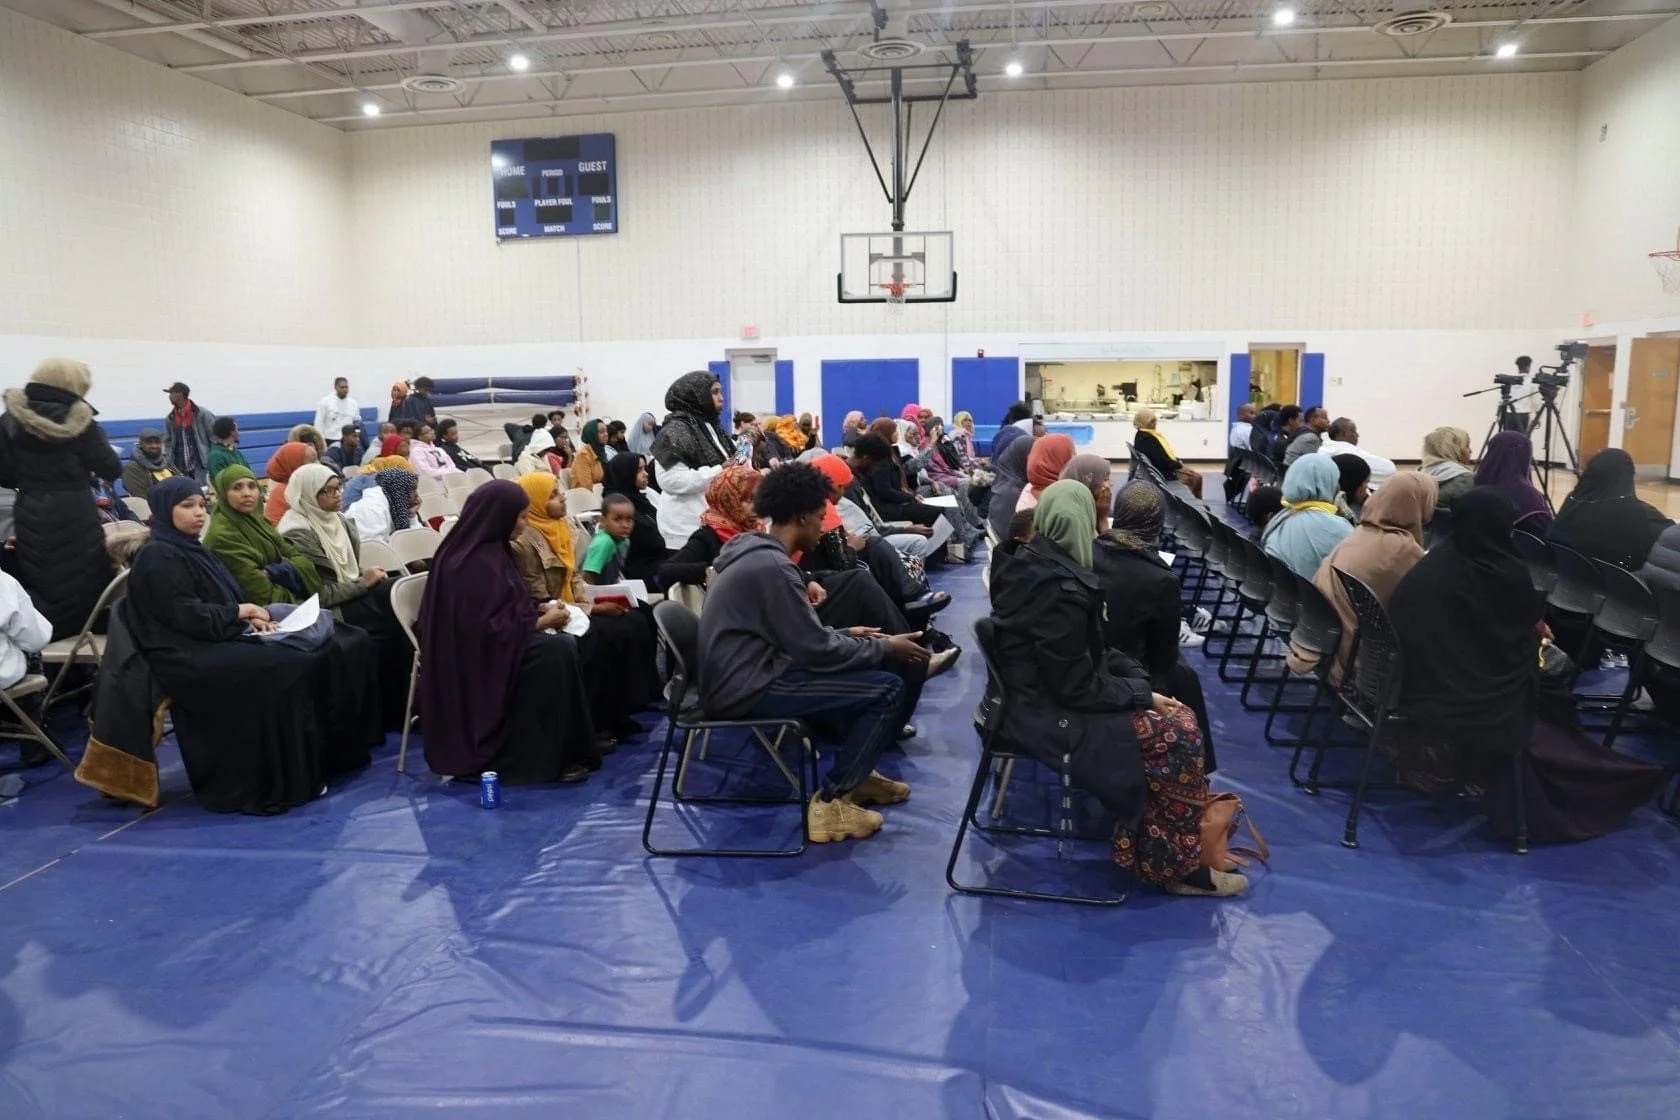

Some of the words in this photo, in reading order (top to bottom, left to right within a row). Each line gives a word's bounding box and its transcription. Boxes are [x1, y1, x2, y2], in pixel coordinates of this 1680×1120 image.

[500, 165, 526, 176] HOME
[578, 161, 607, 172] GUEST
[541, 169, 564, 177] PERIOD
[534, 199, 557, 207] PLAYER
[558, 198, 573, 206] FOUL
[591, 196, 612, 204] FOULS
[497, 201, 516, 209] FOULS
[544, 225, 565, 233] MATCH
[593, 222, 613, 231] SCORE
[498, 227, 517, 235] SCORE
